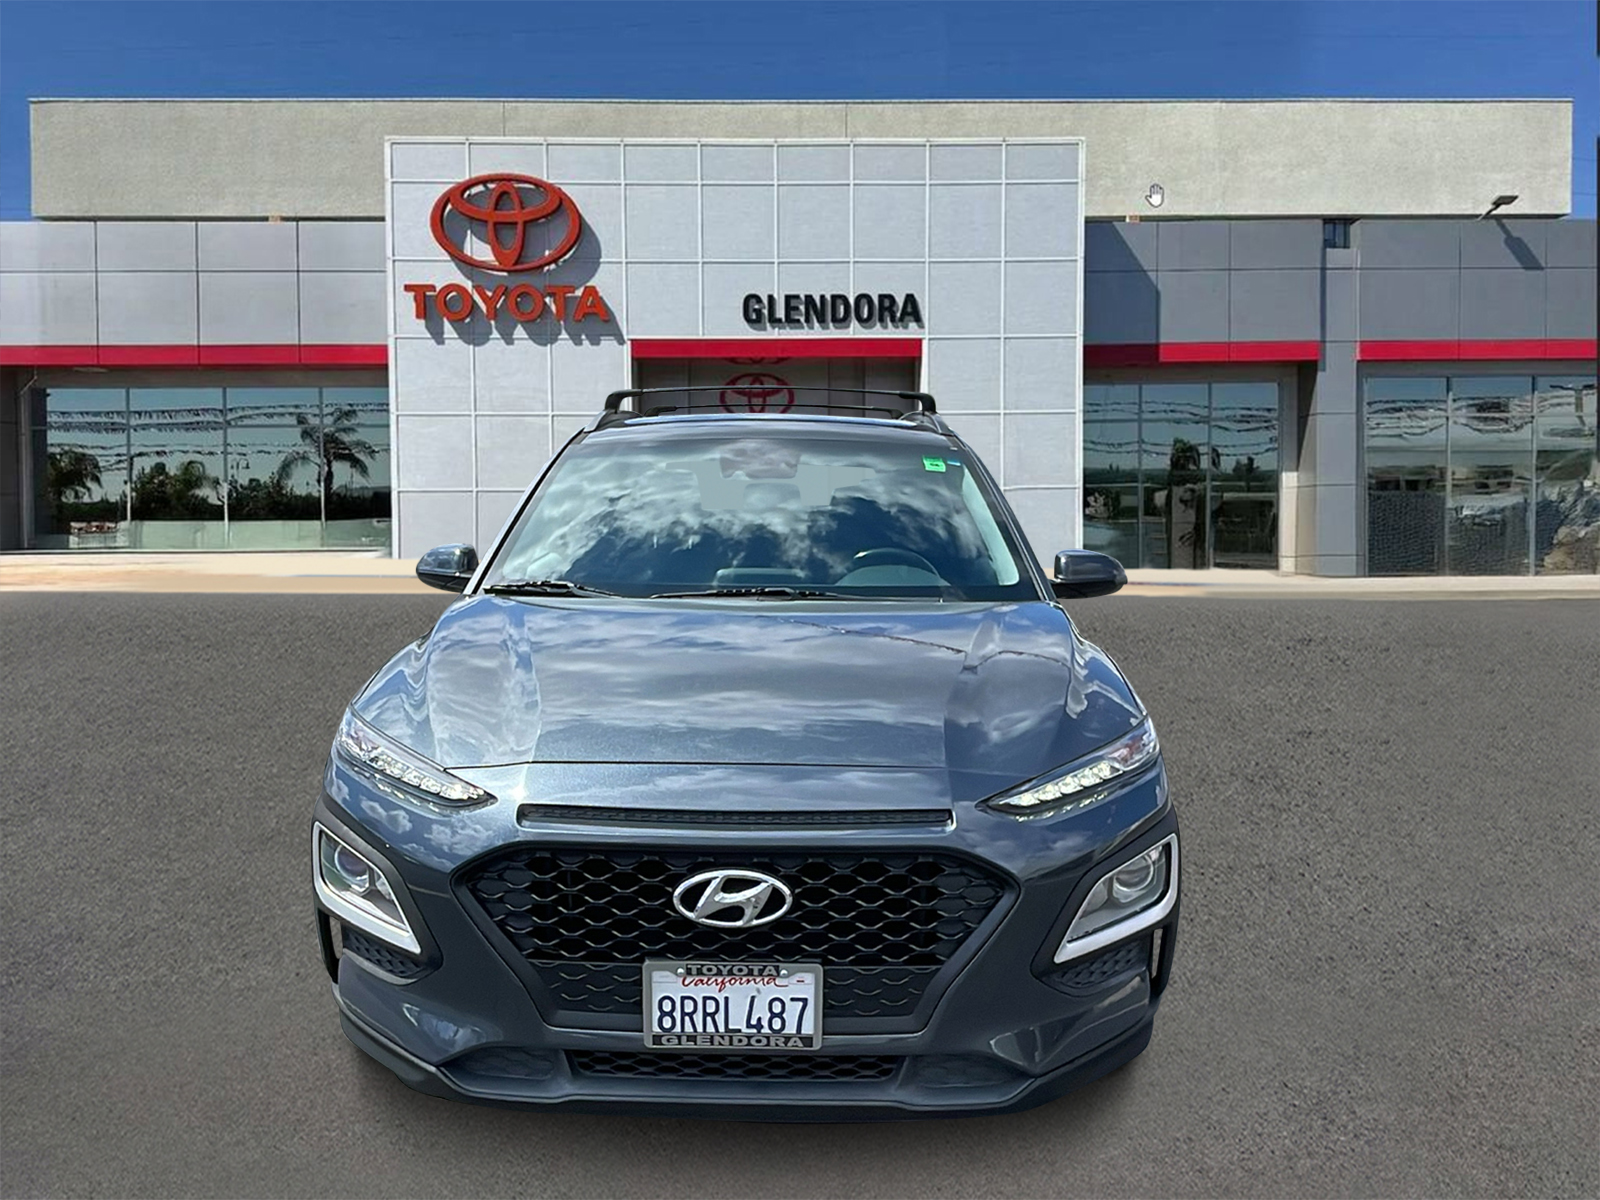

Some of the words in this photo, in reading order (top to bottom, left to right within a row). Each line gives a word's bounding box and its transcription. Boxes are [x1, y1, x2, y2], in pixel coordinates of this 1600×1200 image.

[404, 283, 610, 322] TOYOTA
[742, 293, 922, 325] GLENDORA
[687, 964, 777, 976] TOYOTA
[657, 995, 808, 1034] 8RRL487
[661, 1034, 803, 1048] GLENDORA
